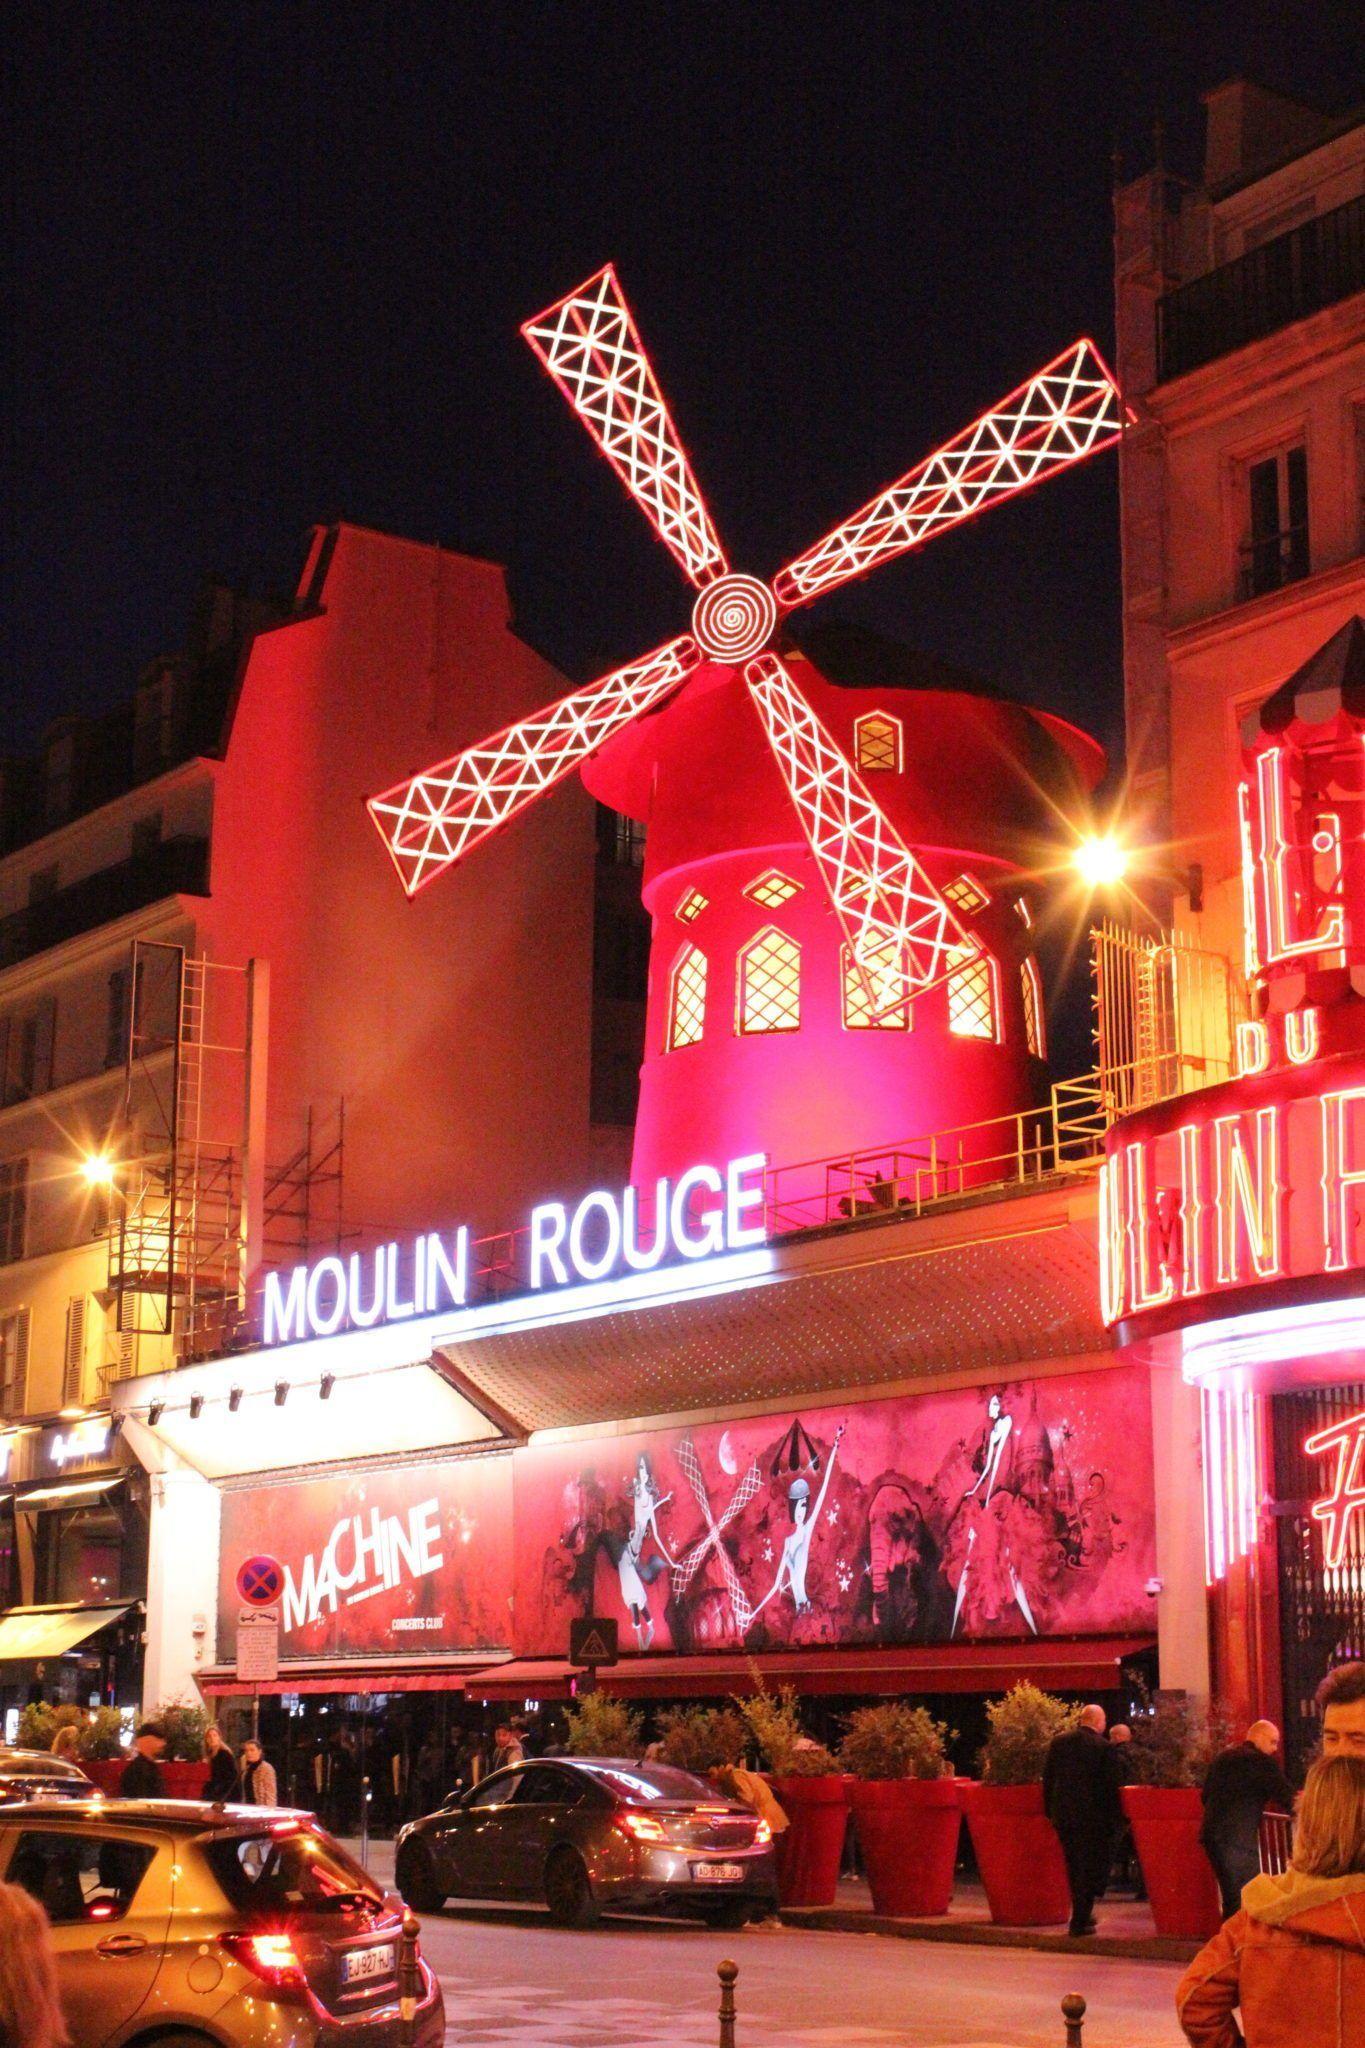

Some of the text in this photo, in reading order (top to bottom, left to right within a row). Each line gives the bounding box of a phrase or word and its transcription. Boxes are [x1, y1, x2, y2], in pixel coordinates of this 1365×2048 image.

[1236, 1008, 1319, 1078] DU
[263, 1152, 769, 1345] MOULIN ROUGE
[281, 1497, 444, 1634] MACHINE
[425, 1617, 444, 1630] CLUB
